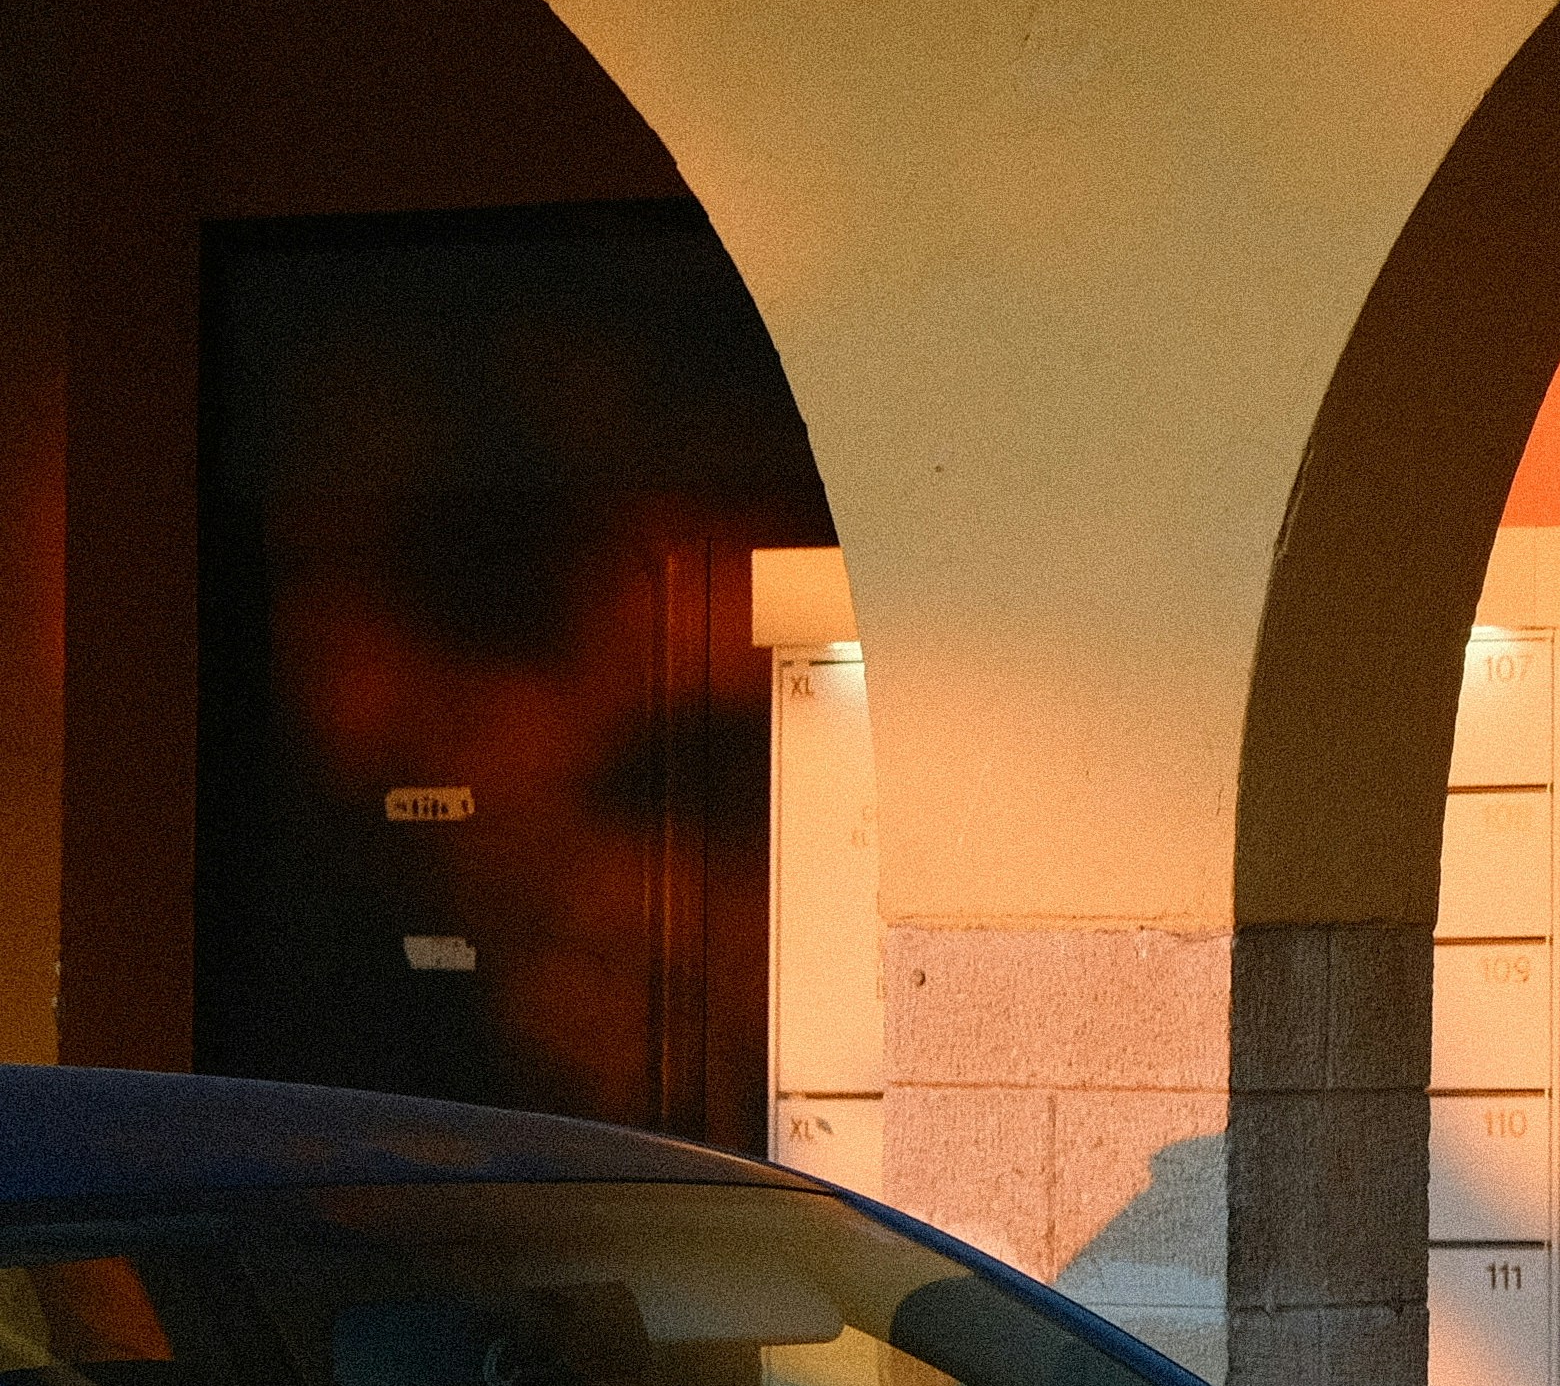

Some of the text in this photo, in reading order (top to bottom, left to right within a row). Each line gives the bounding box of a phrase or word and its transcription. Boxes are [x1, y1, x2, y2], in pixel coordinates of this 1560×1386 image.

[1483, 655, 1534, 682] 107
[791, 676, 814, 697] XL
[1481, 957, 1531, 984] 109
[789, 1119, 814, 1142] XL
[1483, 1110, 1528, 1138] 110
[1486, 1262, 1522, 1290] 111
